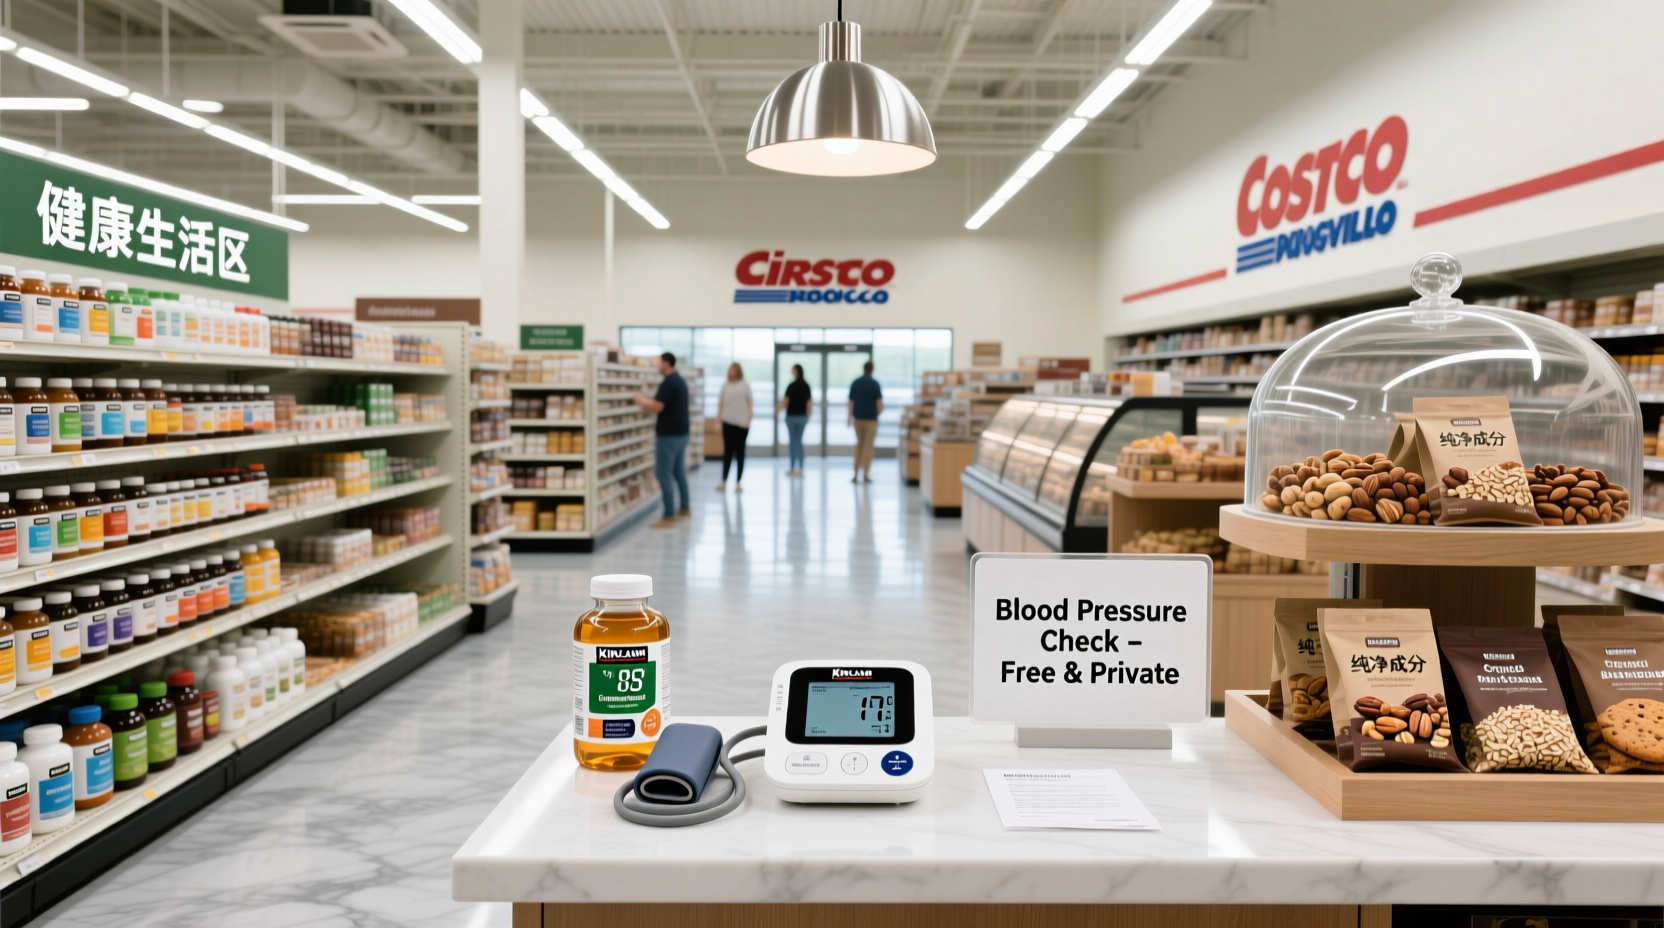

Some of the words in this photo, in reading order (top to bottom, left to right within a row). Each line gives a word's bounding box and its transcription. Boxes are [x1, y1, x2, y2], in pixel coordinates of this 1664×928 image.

[37, 180, 251, 284] 健康生活区
[996, 598, 1068, 621] Blood
[1078, 599, 1187, 622] Pressure
[1040, 629, 1120, 652] Check
[1001, 661, 1056, 683] Free
[1064, 661, 1083, 683] &
[1090, 661, 1180, 684] Private
[1351, 654, 1427, 674] 纯净成分
